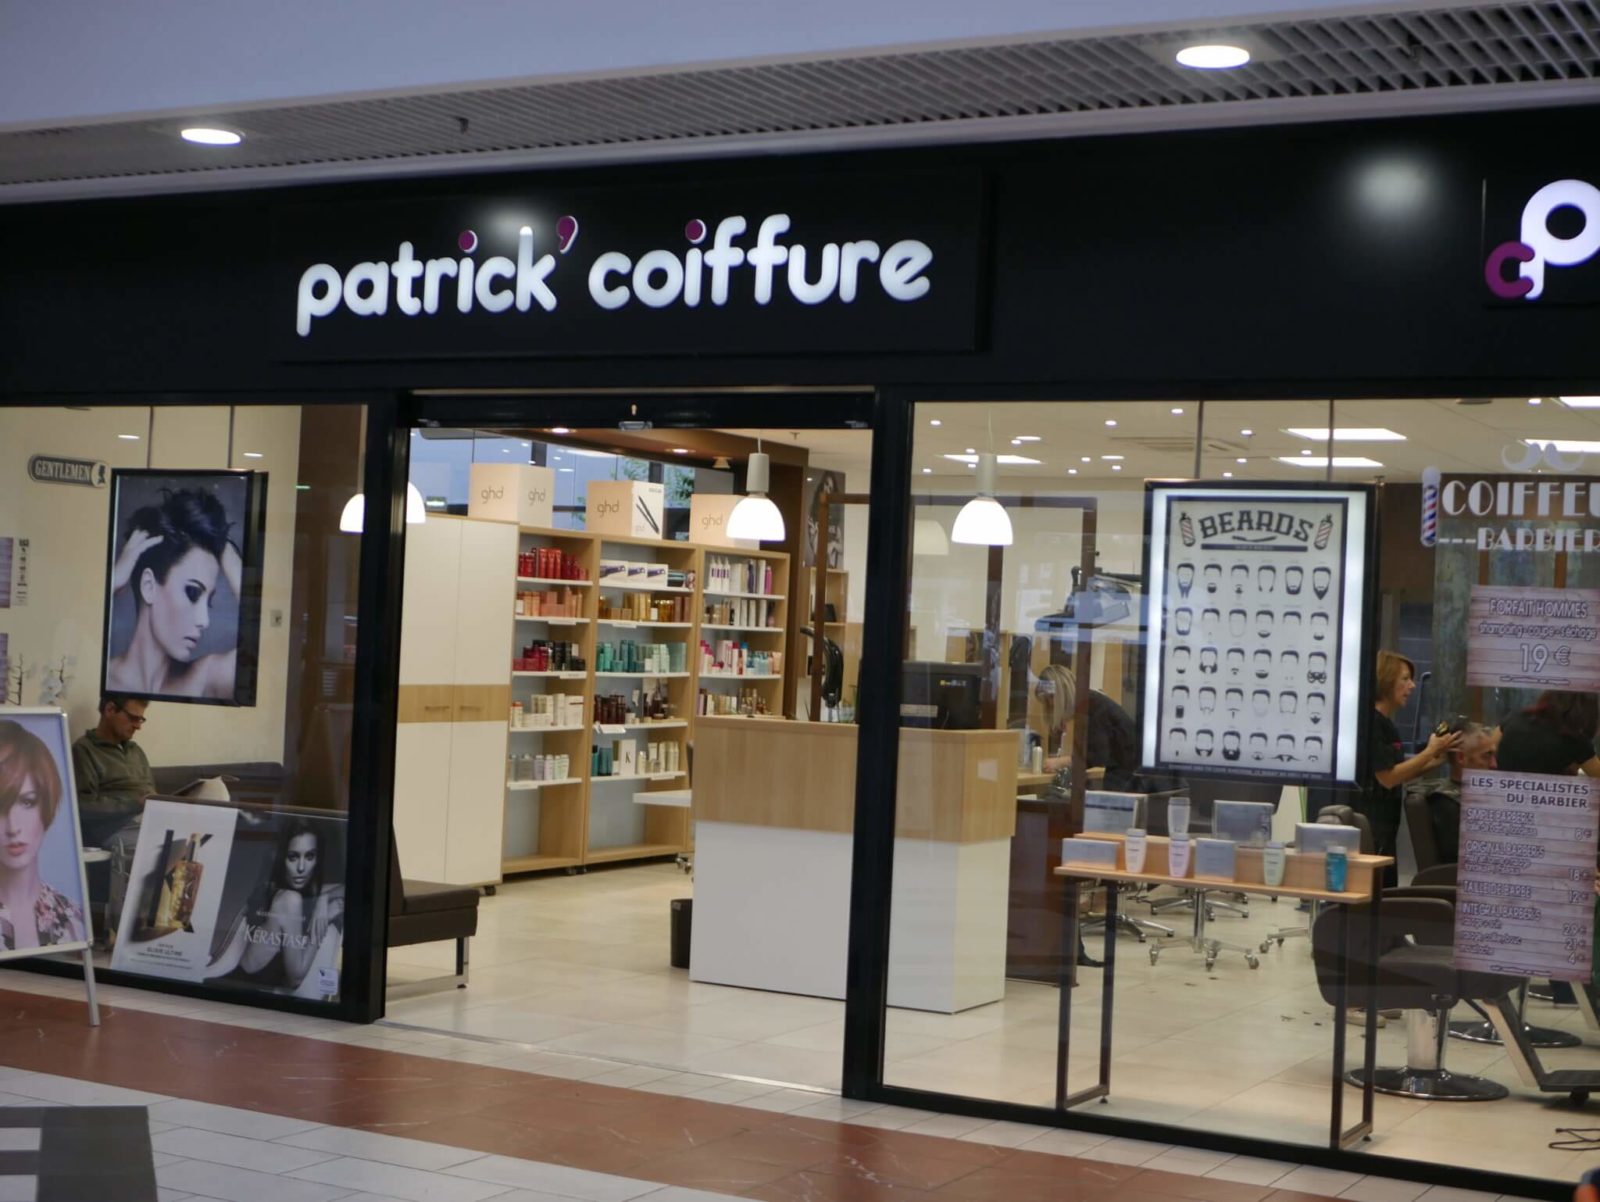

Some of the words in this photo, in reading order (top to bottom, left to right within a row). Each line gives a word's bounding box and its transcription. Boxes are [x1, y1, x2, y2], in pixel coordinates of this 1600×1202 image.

[588, 213, 933, 310] coiffure
[34, 459, 91, 481] GENTLEMEN
[480, 485, 504, 505] ghd
[527, 487, 546, 506] ghd
[597, 499, 620, 518] ghd
[702, 512, 723, 530] ghd
[1198, 510, 1314, 542] BEARDS
[1489, 598, 1534, 617] FORFAIT
[1536, 599, 1588, 618] HOMMES
[1520, 643, 1549, 673] 19
[1471, 777, 1493, 787] LES
[1499, 779, 1590, 795] SPECIALISTES
[1507, 793, 1525, 804] DU
[1531, 795, 1588, 808] BARBIER
